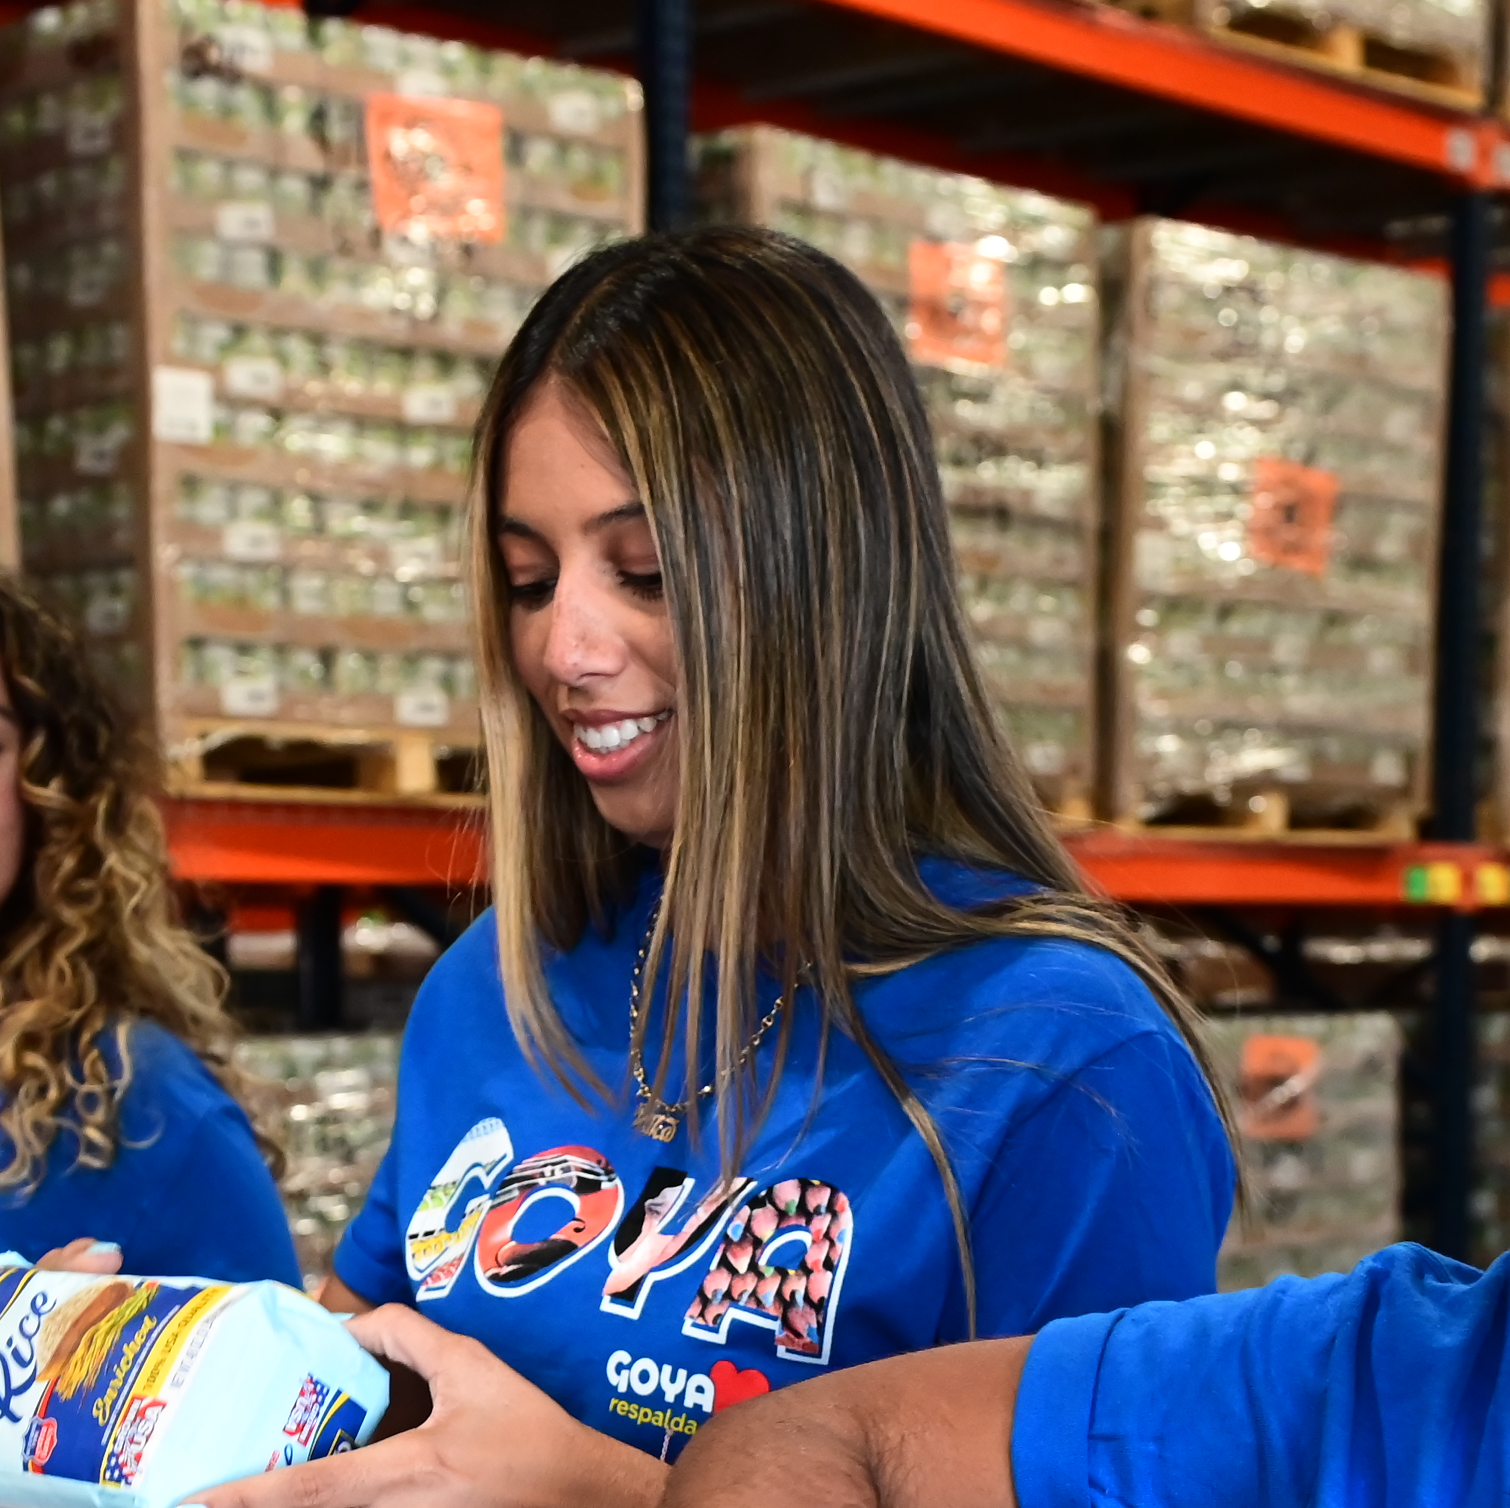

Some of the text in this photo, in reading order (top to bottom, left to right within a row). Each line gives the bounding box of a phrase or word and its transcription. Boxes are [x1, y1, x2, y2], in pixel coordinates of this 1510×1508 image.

[405, 1117, 854, 1364] GOYA
[606, 1350, 715, 1413] GOYA
[131, 1403, 167, 1453] USA
[609, 1397, 699, 1435] respalda
